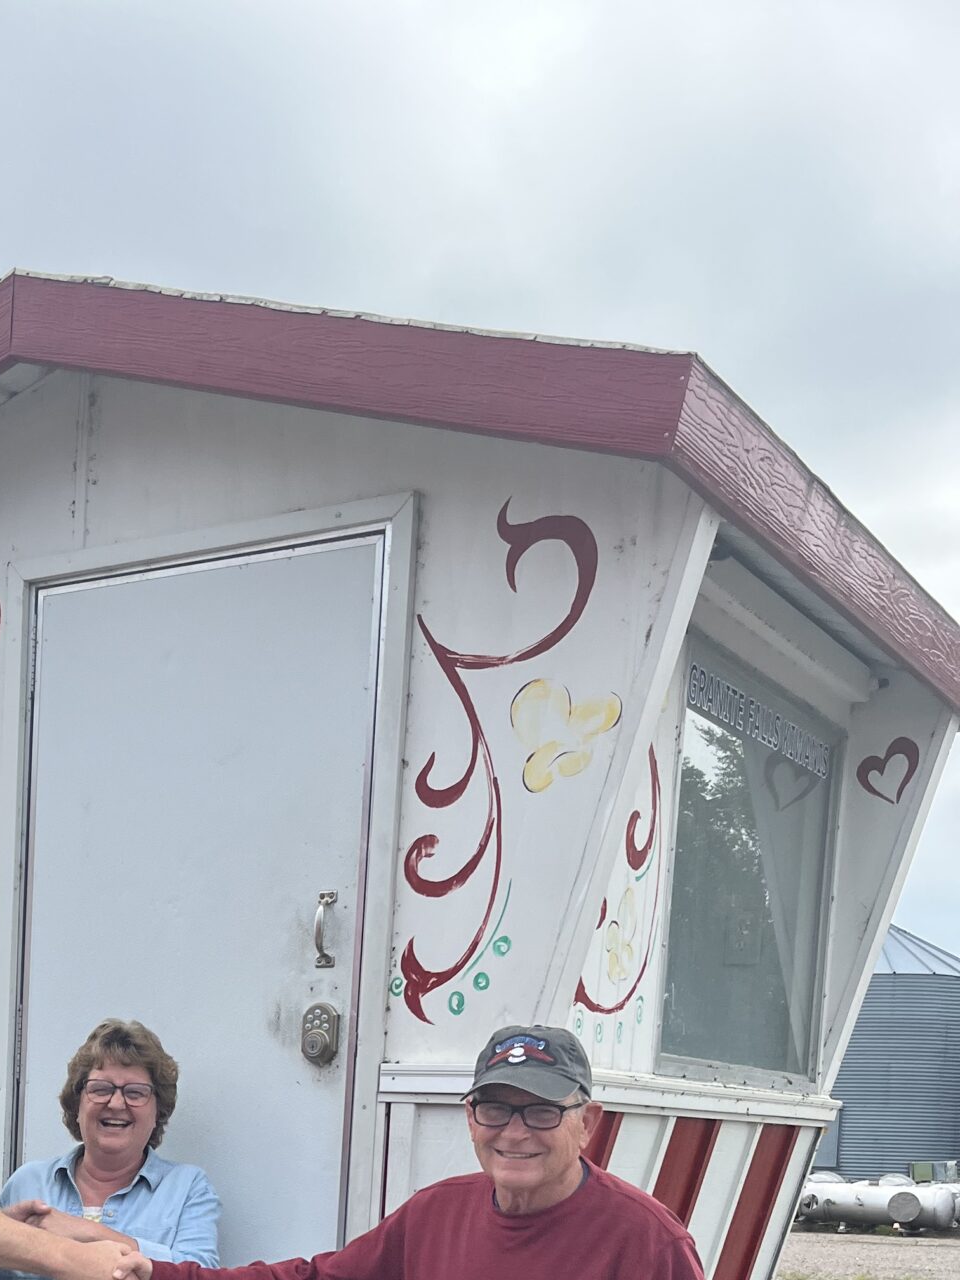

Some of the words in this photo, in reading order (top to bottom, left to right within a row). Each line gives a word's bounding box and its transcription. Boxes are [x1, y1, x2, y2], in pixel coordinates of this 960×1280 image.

[689, 663, 746, 731] GRANITE
[746, 697, 781, 751] FALLS
[781, 719, 830, 779] KIWANIS
